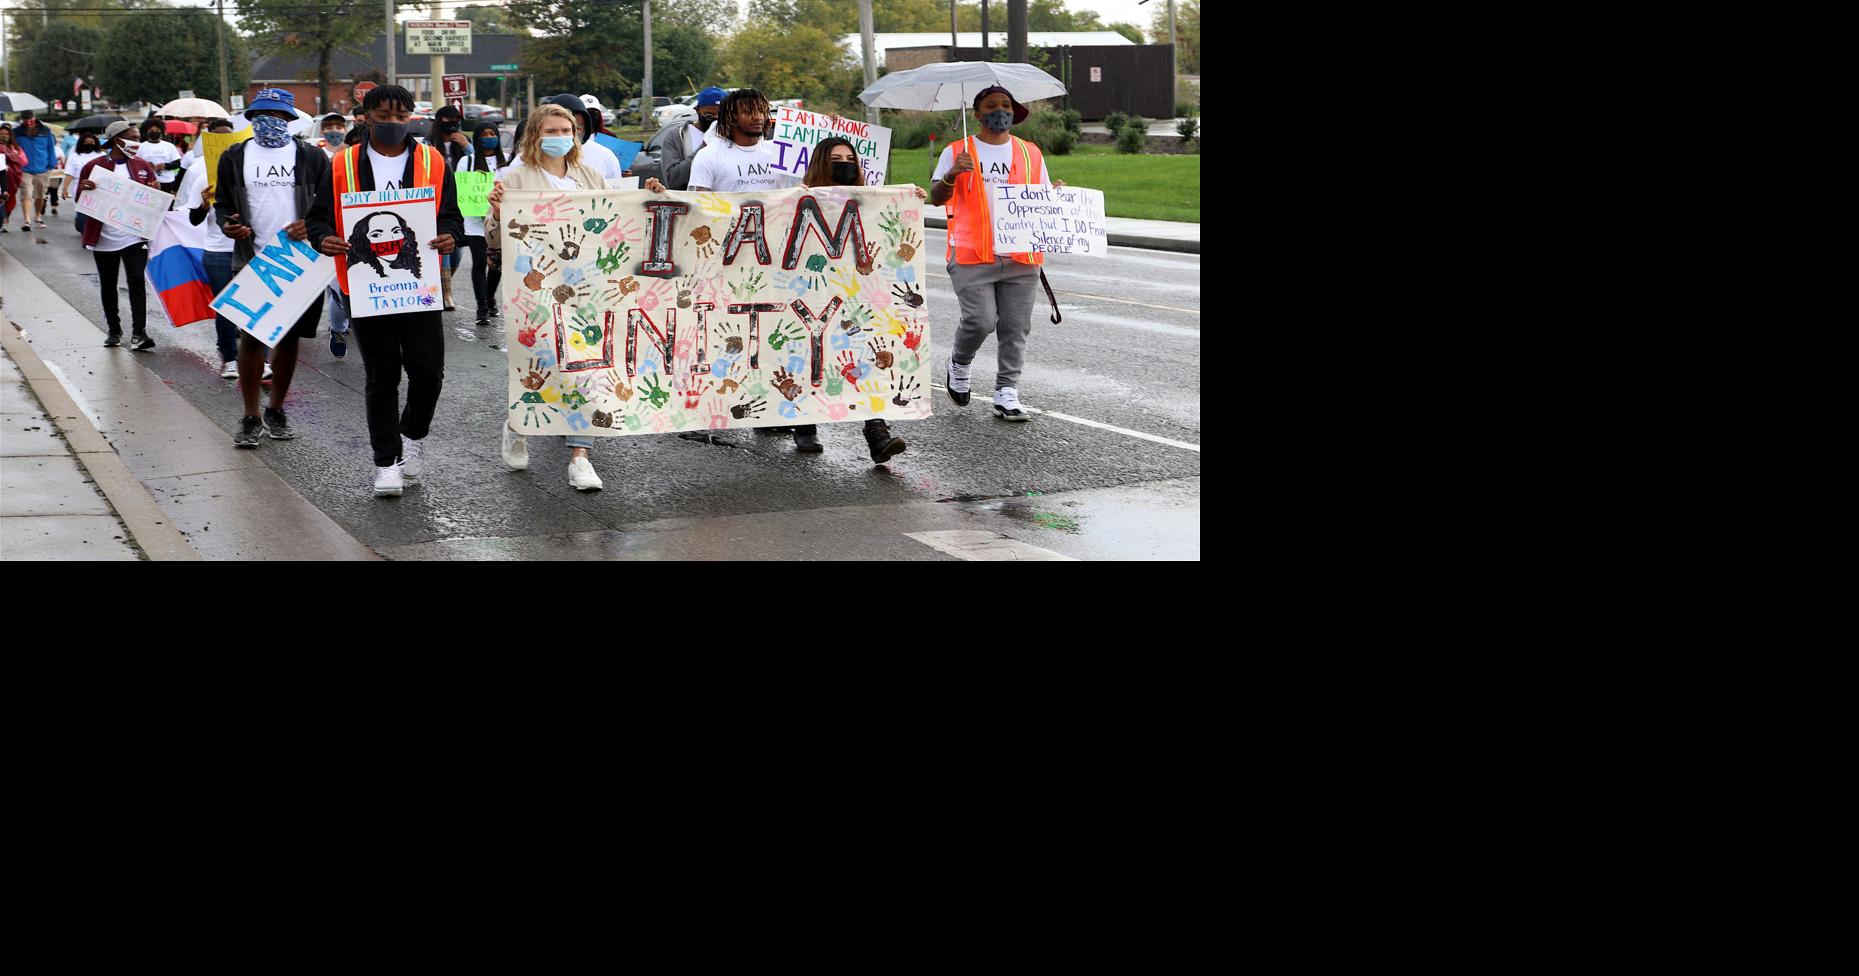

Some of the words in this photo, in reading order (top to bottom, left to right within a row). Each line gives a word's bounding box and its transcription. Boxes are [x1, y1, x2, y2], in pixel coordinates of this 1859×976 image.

[782, 108, 794, 121] I
[795, 111, 815, 126] AM
[818, 112, 870, 139] STRONG.
[779, 123, 792, 139] I
[793, 125, 815, 144] AM
[770, 140, 793, 171] I
[792, 147, 809, 174] A
[256, 165, 260, 178] I
[266, 164, 296, 178] AM
[737, 164, 742, 177] I
[747, 163, 773, 176] AM
[980, 161, 984, 174] I
[253, 180, 269, 188] The
[737, 179, 750, 187] The
[750, 178, 776, 186] Change
[343, 191, 371, 206] SAY
[378, 188, 401, 203] HER
[405, 187, 435, 200] NAME
[997, 186, 1016, 200] I
[1020, 184, 1051, 202] don't
[1056, 186, 1077, 203] fear
[1008, 201, 1064, 218] Oppression
[1039, 218, 1057, 230] but
[1061, 217, 1071, 232] I
[1074, 219, 1087, 234] DO
[640, 200, 690, 277] I
[722, 194, 873, 270] AM
[998, 233, 1017, 245] the
[1029, 231, 1064, 245] Silence
[1067, 233, 1076, 246] of
[1078, 236, 1090, 252] my
[1032, 244, 1073, 254] PEOPLE
[212, 283, 274, 331] I
[247, 228, 321, 298] AM
[368, 281, 419, 294] Breonna
[551, 295, 844, 388] UNITY
